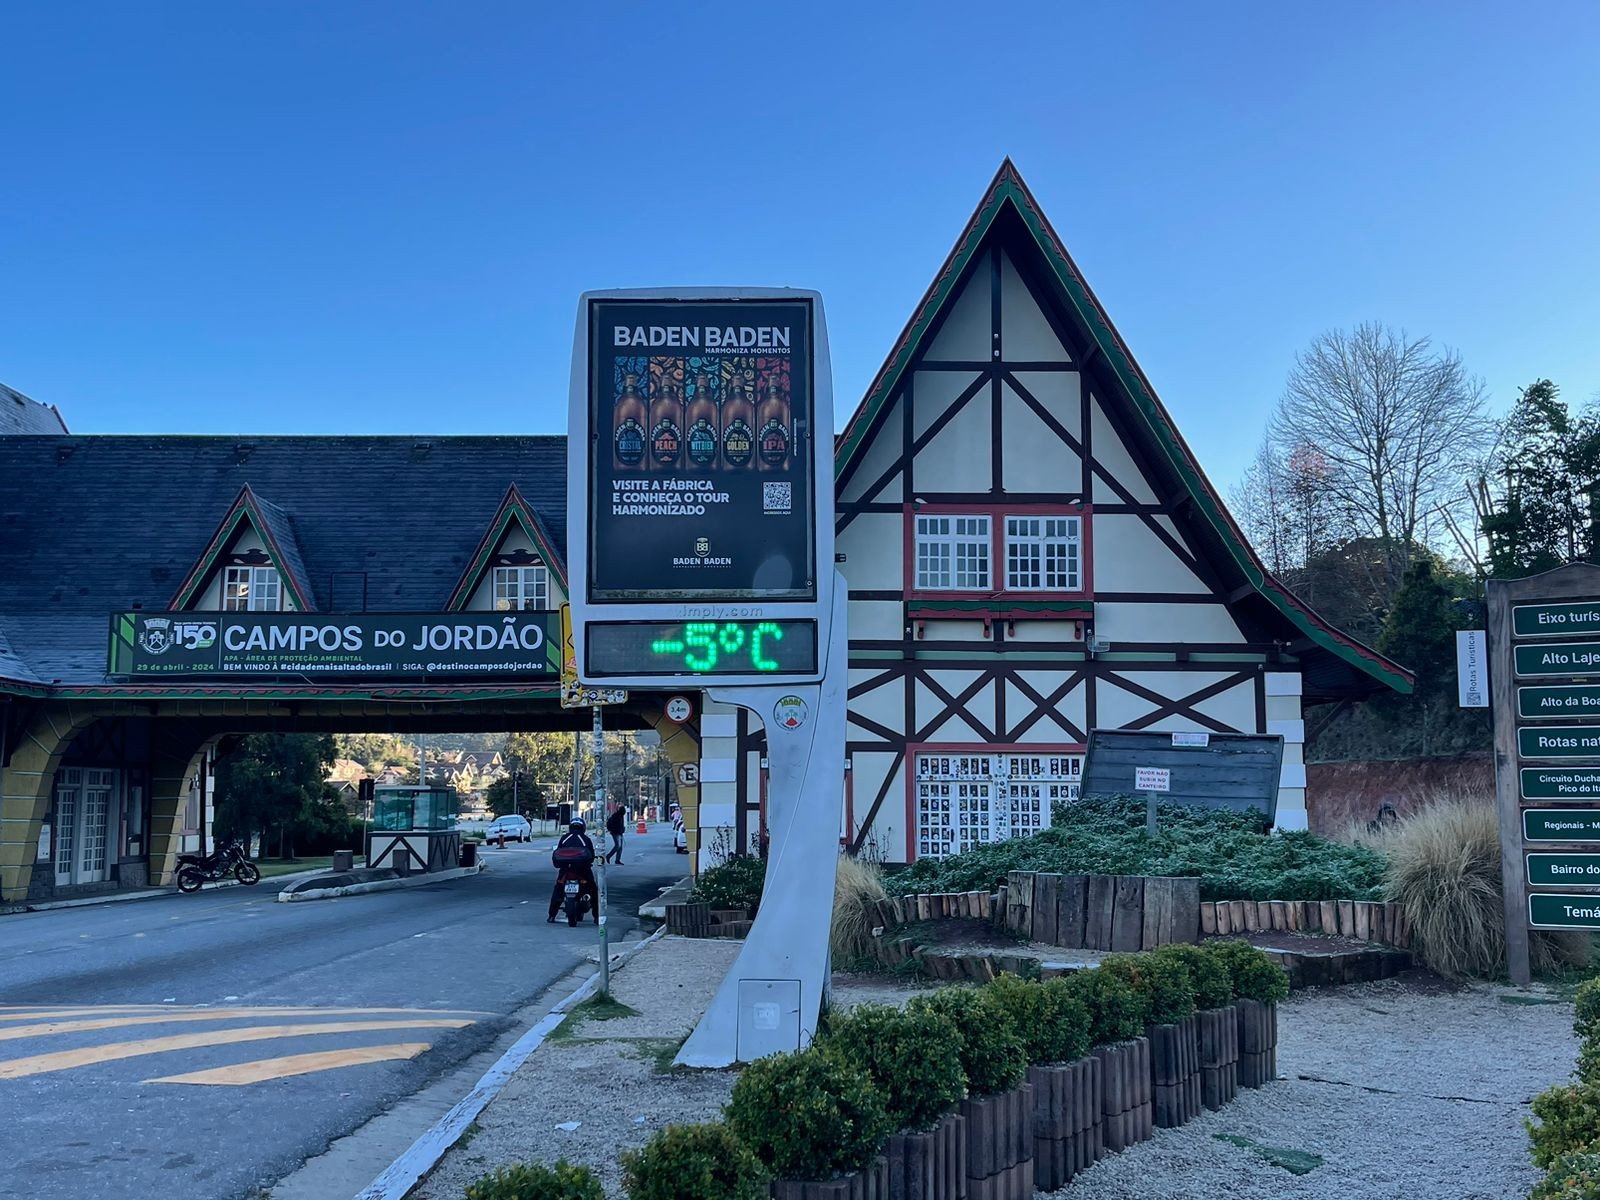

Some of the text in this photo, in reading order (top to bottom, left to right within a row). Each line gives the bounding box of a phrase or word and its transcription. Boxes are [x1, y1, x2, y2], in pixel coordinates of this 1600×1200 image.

[614, 326, 790, 346] BADEN BADEN
[727, 441, 750, 450] GOLDEN
[764, 441, 784, 450] IPA
[612, 478, 714, 490] VISITE A FÁBRICA
[612, 493, 730, 505] E CONHEÇA O TOUR
[612, 505, 705, 514] HARMONIZADO
[683, 606, 763, 618] imply.com
[1538, 613, 1566, 624] Eixo
[174, 626, 216, 650] 150
[224, 616, 543, 651] CAMPOS DO JORDÃO
[280, 654, 318, 662] PROTEÇÃO
[1542, 652, 1600, 665] Alto Laje
[272, 662, 278, 670] À
[426, 662, 542, 672] @destinocamposdojordao
[1541, 698, 1562, 706] Alto
[1565, 696, 1578, 706] da
[1539, 737, 1578, 747] Rotas
[1540, 774, 1572, 782] Circuito
[1544, 821, 1584, 830] Regionais
[1551, 864, 1584, 874] Bairro
